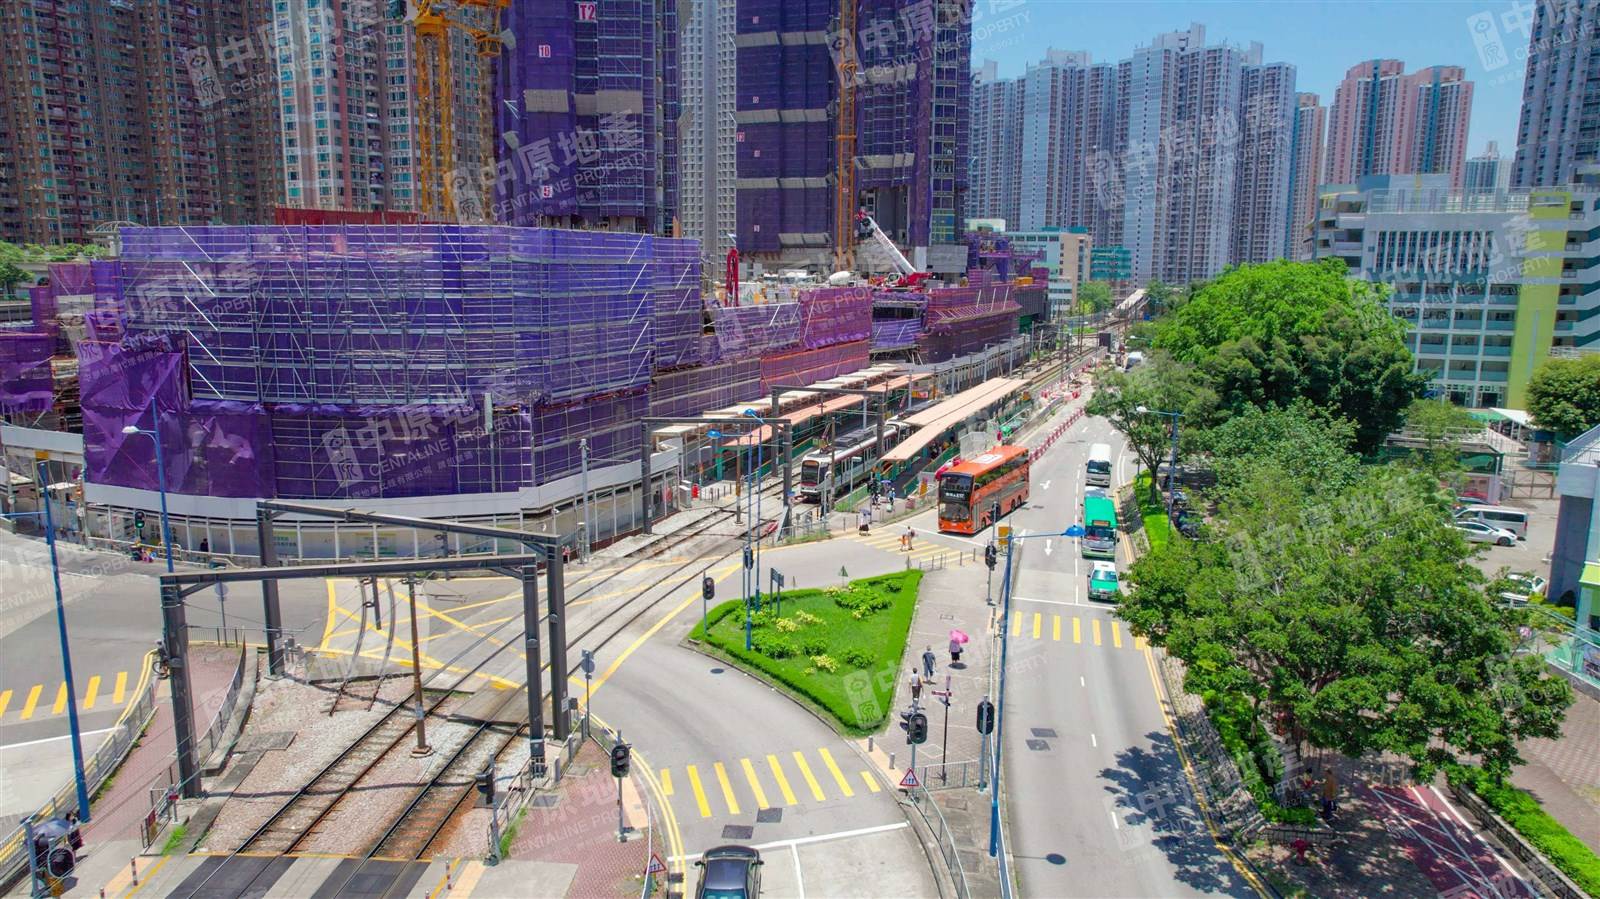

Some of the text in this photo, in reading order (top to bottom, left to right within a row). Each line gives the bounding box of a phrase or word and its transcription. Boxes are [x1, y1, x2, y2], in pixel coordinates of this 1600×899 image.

[579, 3, 596, 21] T2
[539, 45, 550, 57] 10
[544, 187, 550, 196] 5
